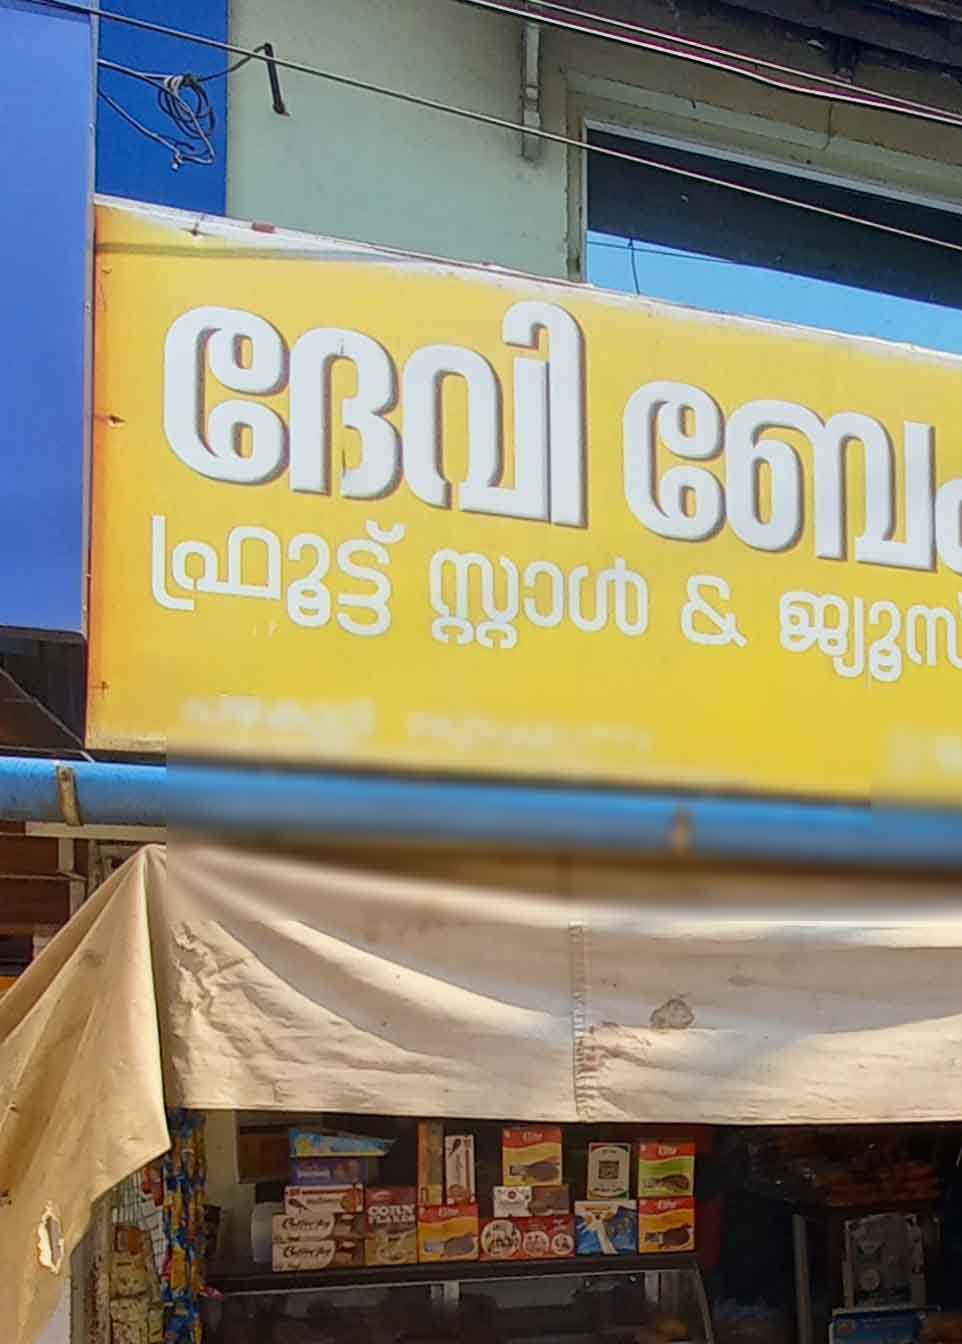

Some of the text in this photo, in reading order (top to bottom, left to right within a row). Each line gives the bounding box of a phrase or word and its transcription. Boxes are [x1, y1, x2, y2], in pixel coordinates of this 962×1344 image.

[162, 300, 589, 529] ദേവി
[150, 514, 406, 638] ഫ്രൂട്ട്
[430, 548, 650, 649] സ്റ്റാൾ
[679, 574, 749, 648] &
